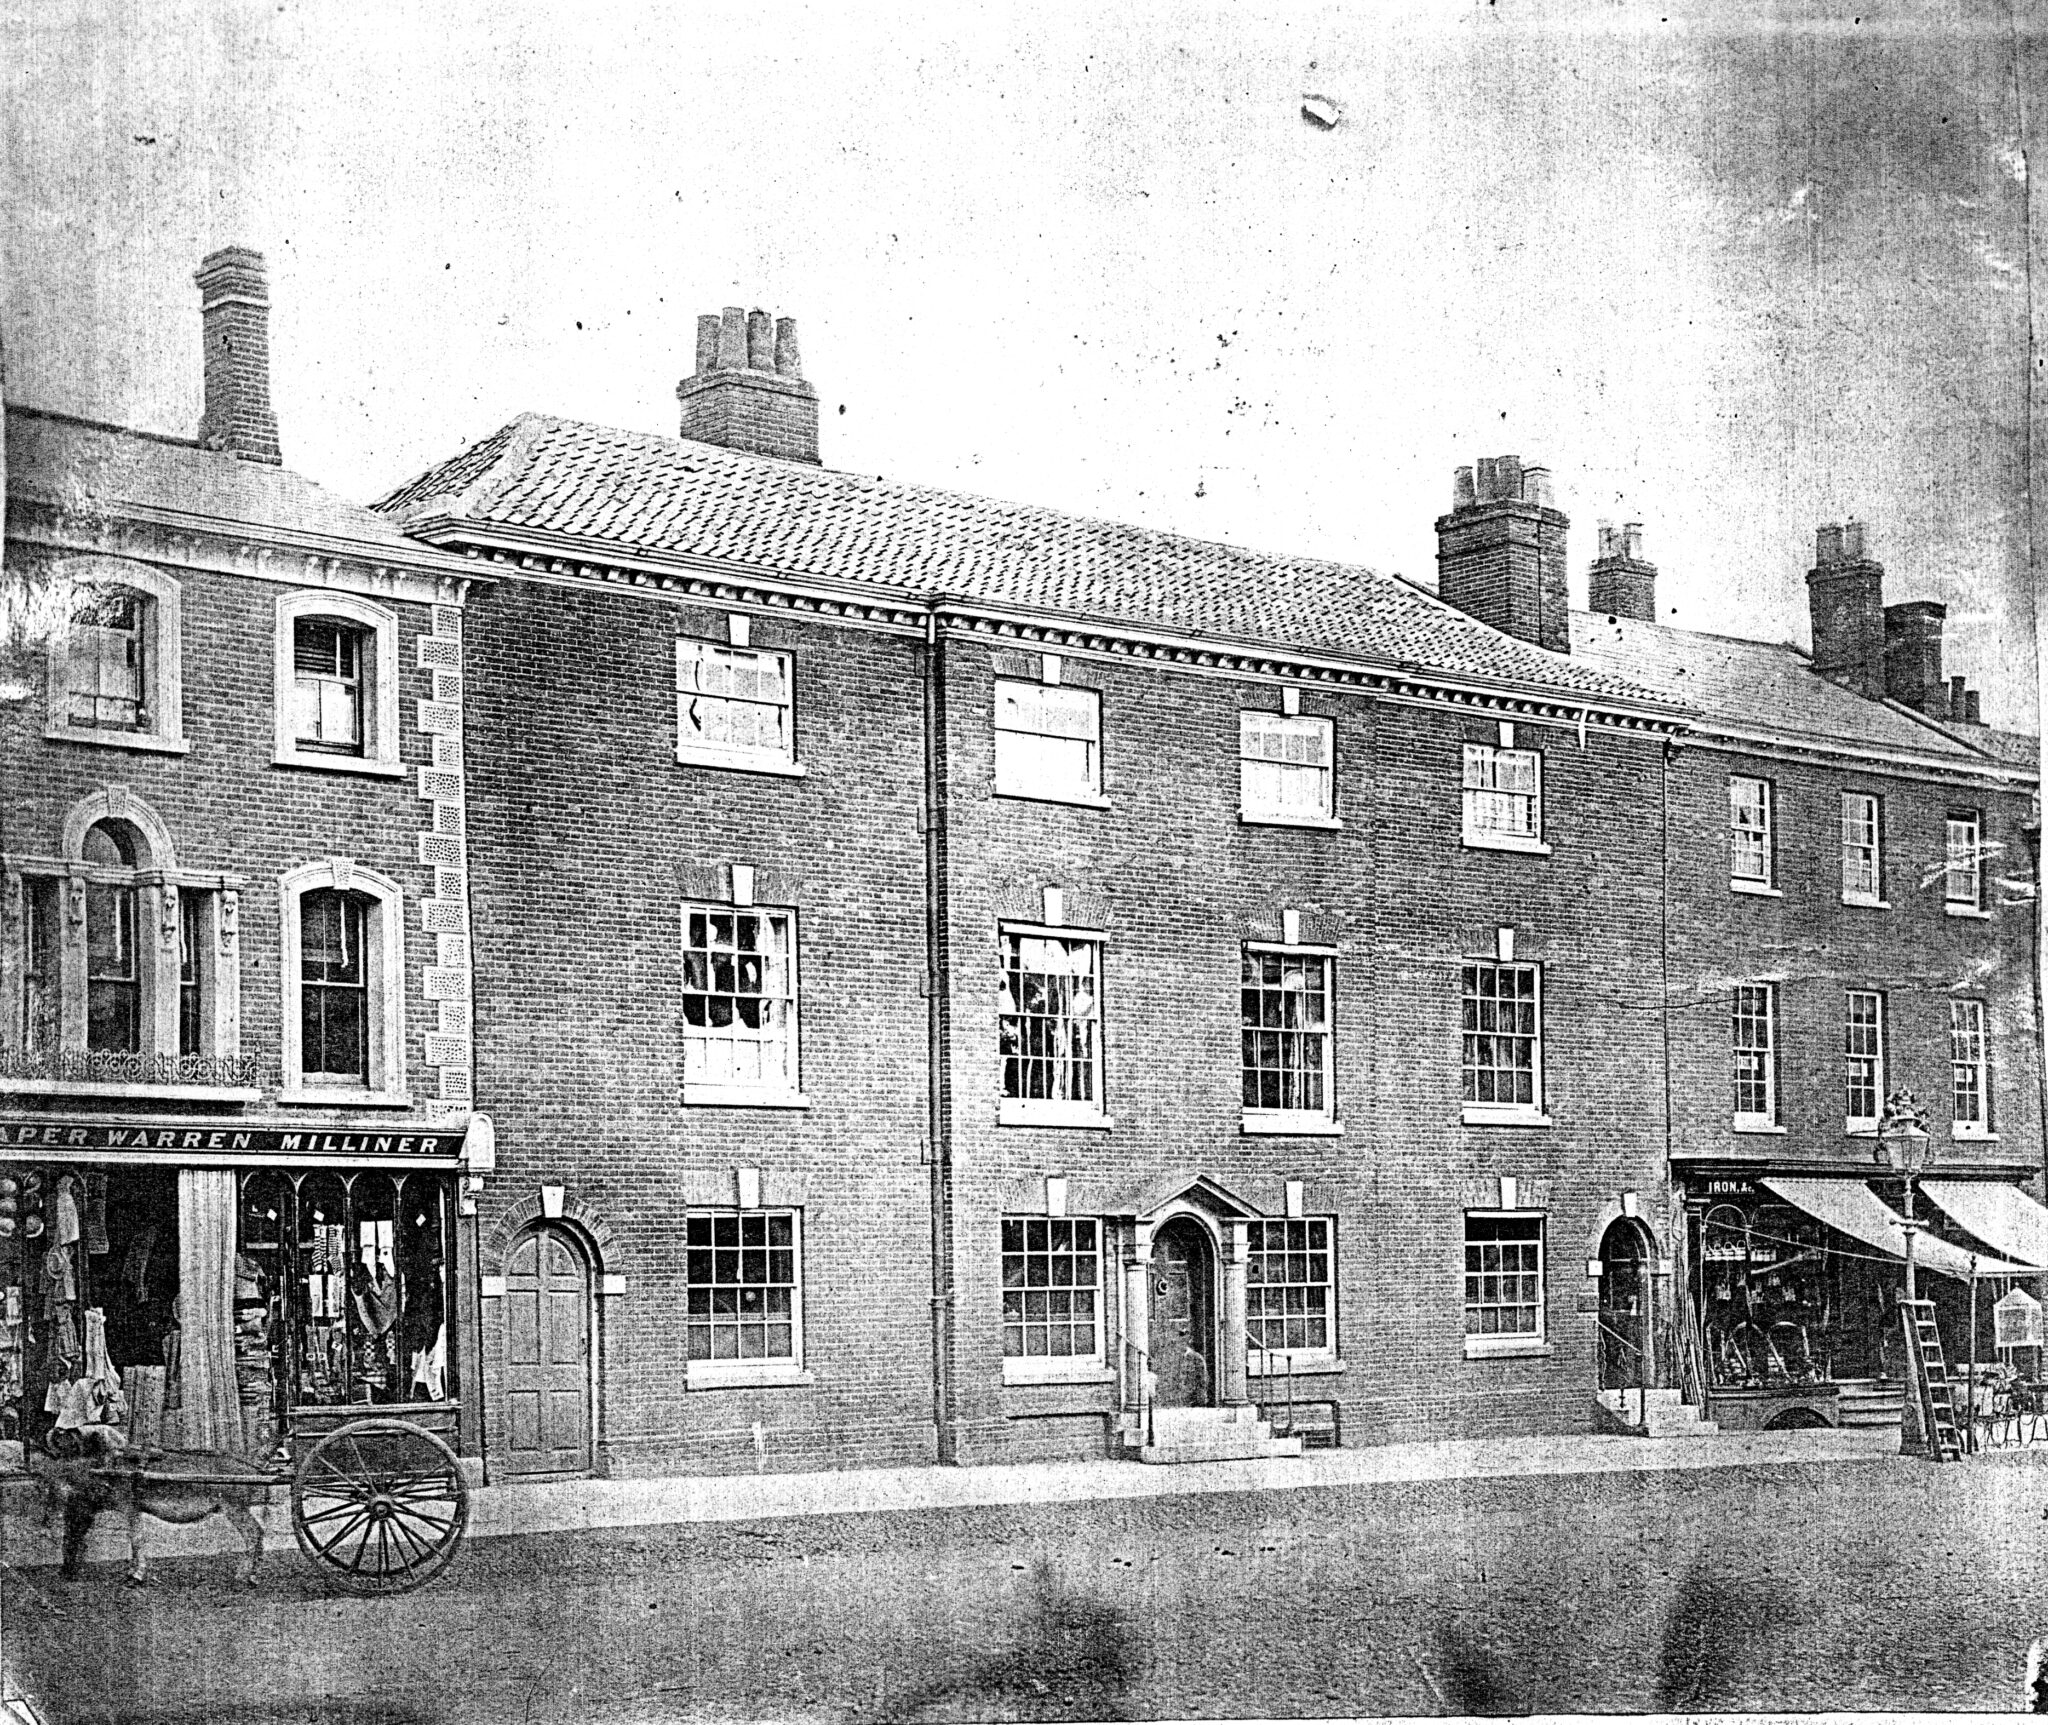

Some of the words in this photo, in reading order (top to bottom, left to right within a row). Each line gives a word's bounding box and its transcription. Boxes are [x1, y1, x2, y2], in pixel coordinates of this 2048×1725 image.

[108, 1130, 251, 1149] WARREN
[280, 1134, 438, 1153] MILLINER
[1709, 1181, 1740, 1194] IRON,
